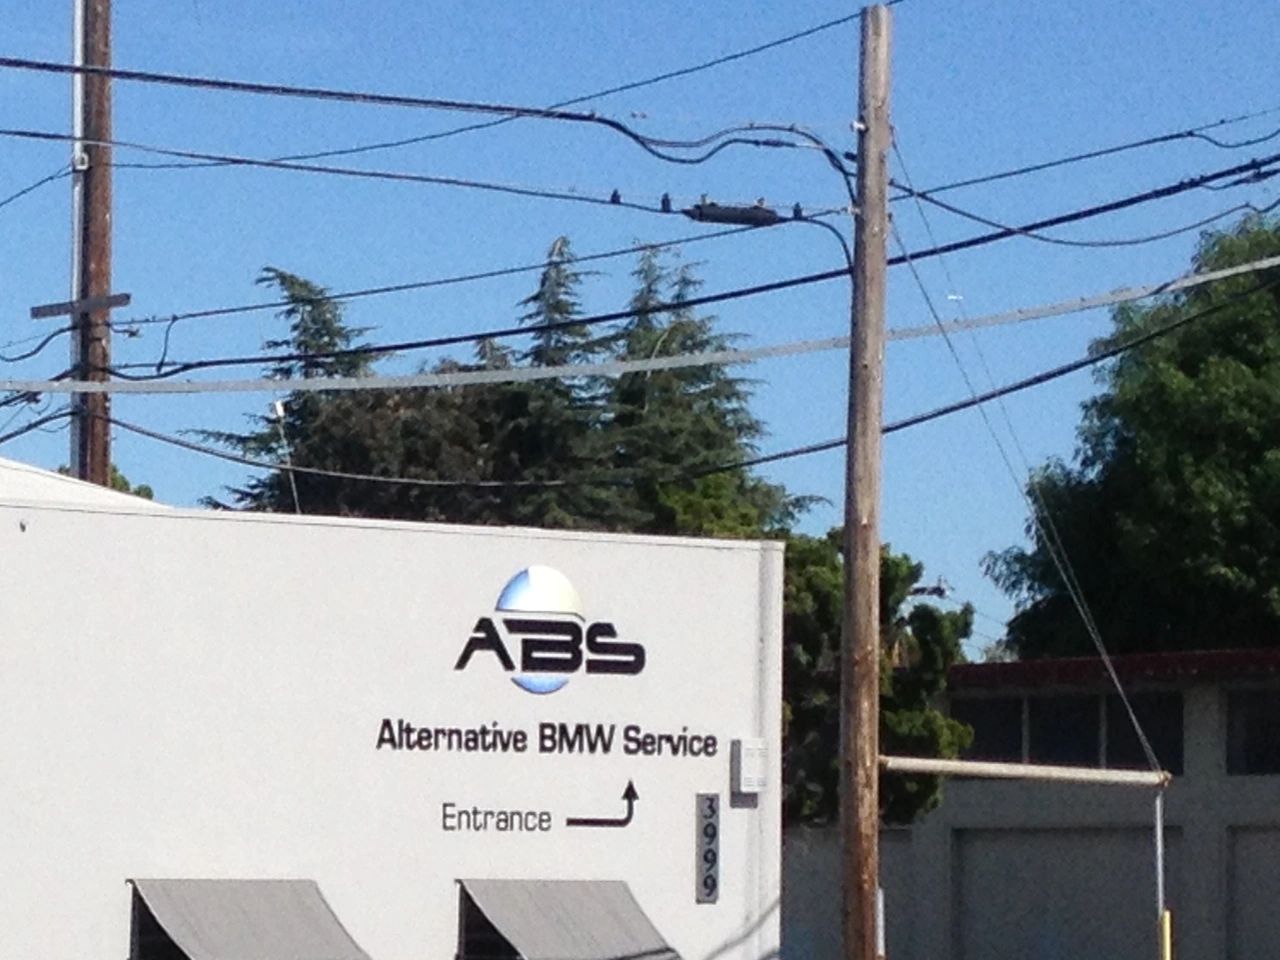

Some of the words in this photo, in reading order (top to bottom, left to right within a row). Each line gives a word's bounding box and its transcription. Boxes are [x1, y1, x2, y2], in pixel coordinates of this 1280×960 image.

[455, 617, 646, 675] ABS
[376, 718, 527, 753] Alternative
[538, 722, 615, 755] BMW
[623, 724, 718, 757] Service
[442, 802, 552, 832] Entrance
[703, 797, 717, 898] 3999
